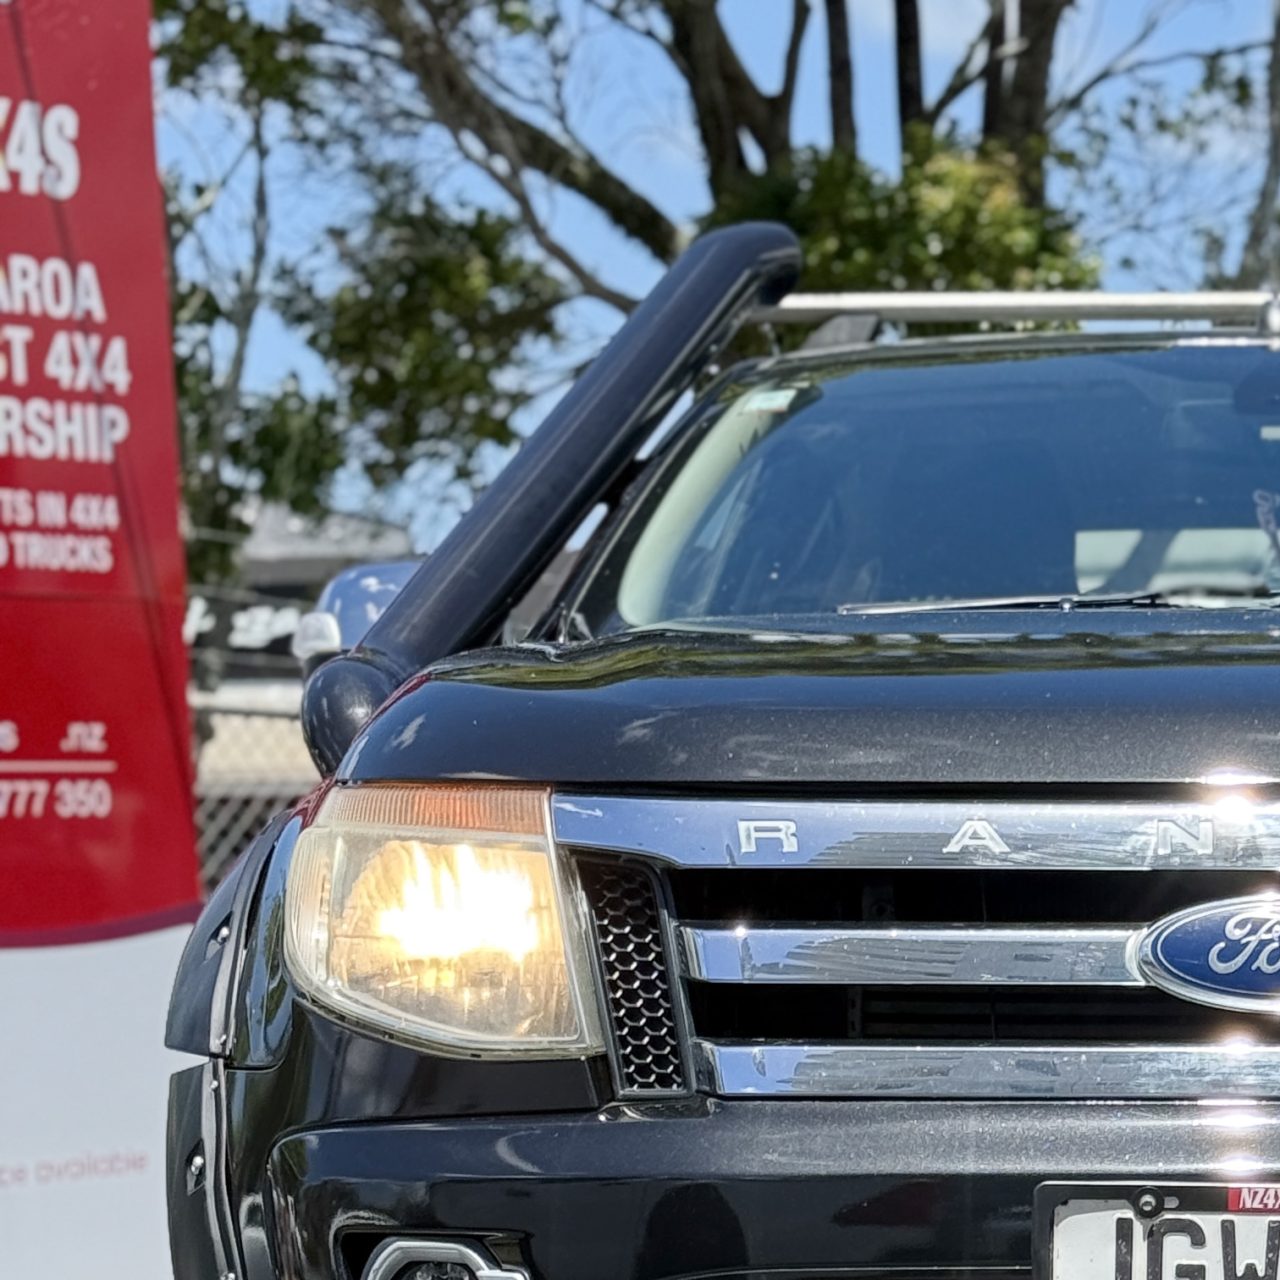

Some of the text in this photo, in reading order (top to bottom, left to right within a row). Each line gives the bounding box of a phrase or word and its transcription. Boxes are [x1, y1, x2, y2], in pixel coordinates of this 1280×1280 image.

[0, 324, 132, 397] T 4X4
[53, 779, 113, 819] 350
